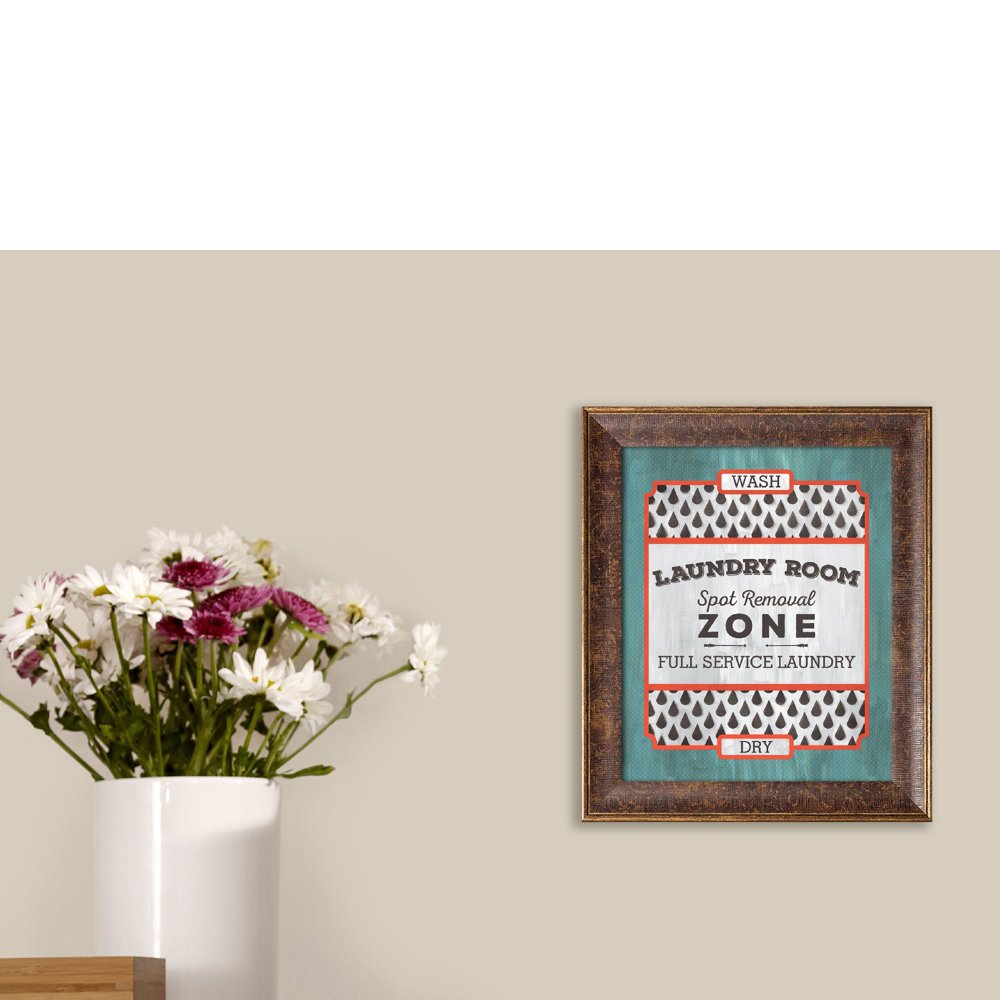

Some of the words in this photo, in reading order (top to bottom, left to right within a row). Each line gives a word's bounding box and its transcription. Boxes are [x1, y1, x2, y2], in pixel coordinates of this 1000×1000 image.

[731, 475, 781, 489] WASH
[652, 559, 776, 587] LAUNDRY
[784, 559, 861, 587] ROOM
[697, 589, 737, 612] Spot
[741, 589, 816, 607] Removal
[698, 613, 816, 639] ZONE
[658, 655, 698, 669] FULL
[702, 655, 773, 669] SERVICE
[777, 655, 856, 669] LAUNDRY
[739, 740, 773, 753] DRY
